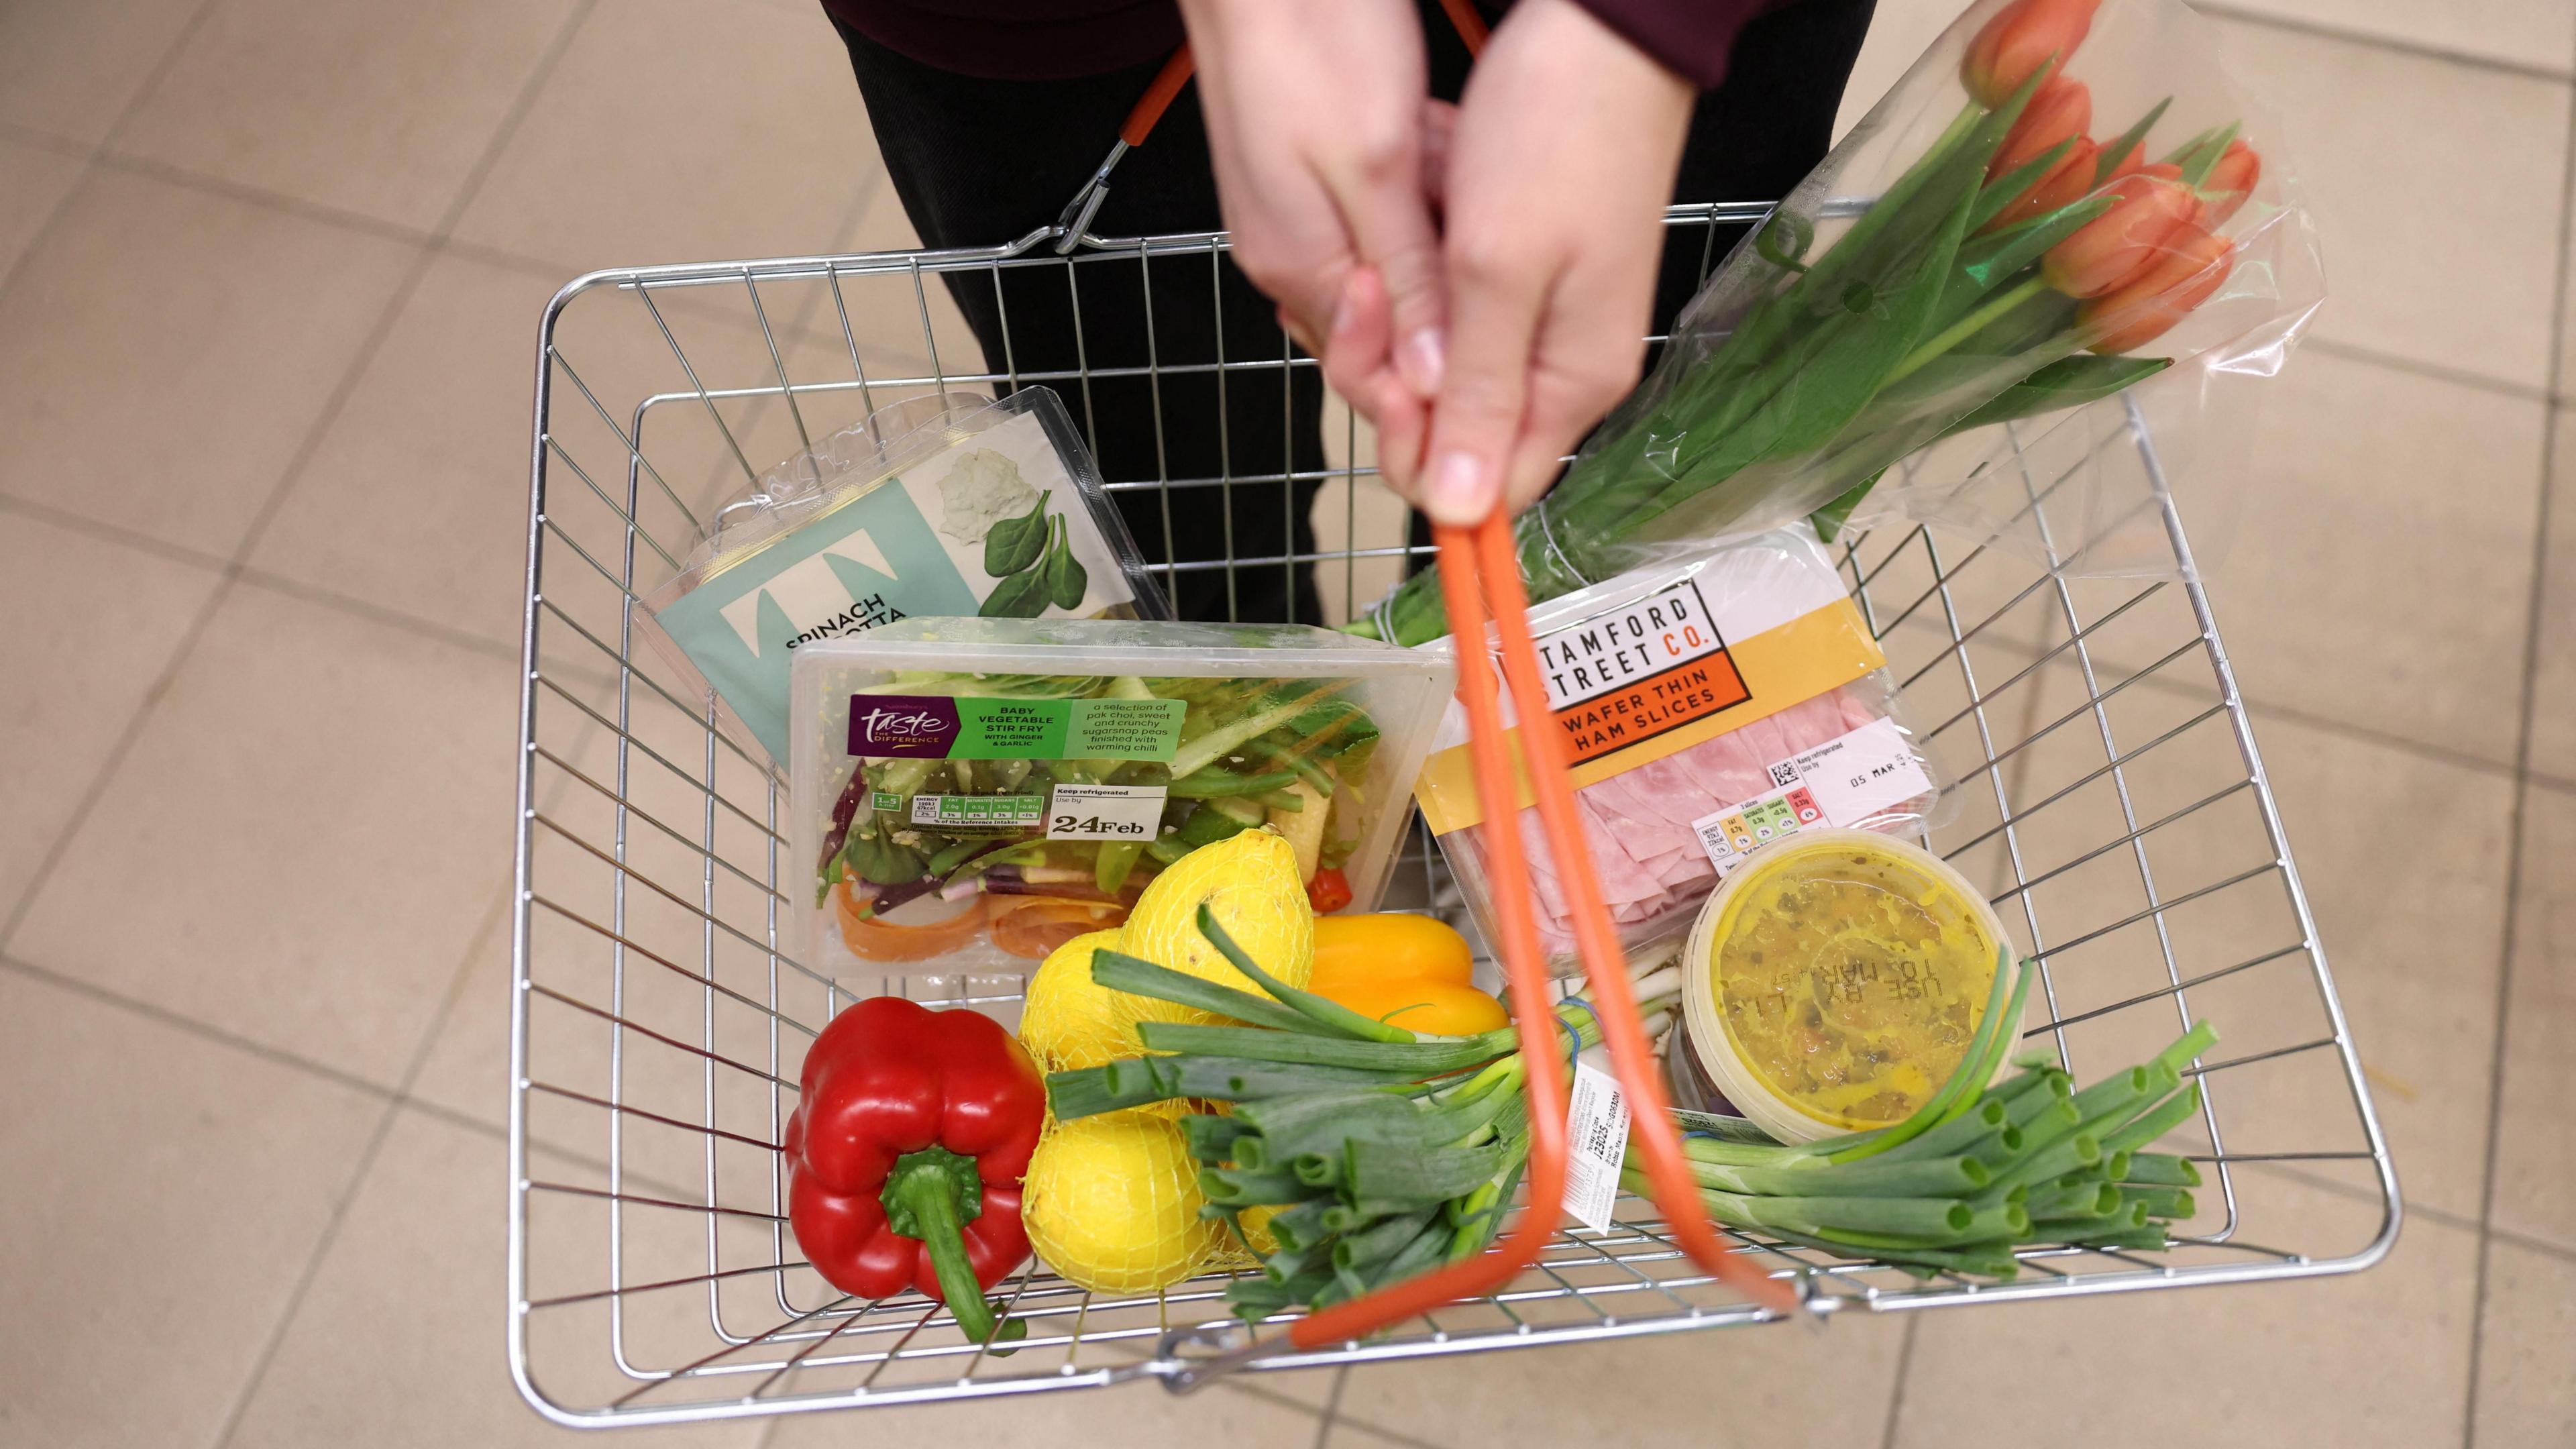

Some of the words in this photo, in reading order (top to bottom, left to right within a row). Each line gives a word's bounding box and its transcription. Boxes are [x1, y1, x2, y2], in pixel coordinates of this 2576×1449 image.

[1540, 599, 1687, 669] TAMFORD
[1543, 643, 1651, 701] TREET
[1663, 625, 1709, 655] CO.
[1562, 694, 1644, 733] WAFER
[1652, 669, 1708, 699] THIN
[861, 708, 950, 743] taste
[979, 716, 1054, 724] VEGETABLE
[1087, 712, 1107, 720] pak
[1117, 720, 1160, 728] crunchy
[1575, 722, 1625, 751] HAM
[1634, 689, 1714, 728] SLICES
[1086, 743, 1131, 751] warming
[1796, 755, 1812, 765] Keep
[1811, 743, 1843, 759] refrigerated
[1850, 775, 1866, 788] 05
[1871, 763, 1894, 778] MAR
[1792, 791, 1803, 799] SALT
[1702, 826, 1718, 836] ENERGY
[1819, 963, 1878, 984] MAR
[1884, 979, 1943, 1000] USE
